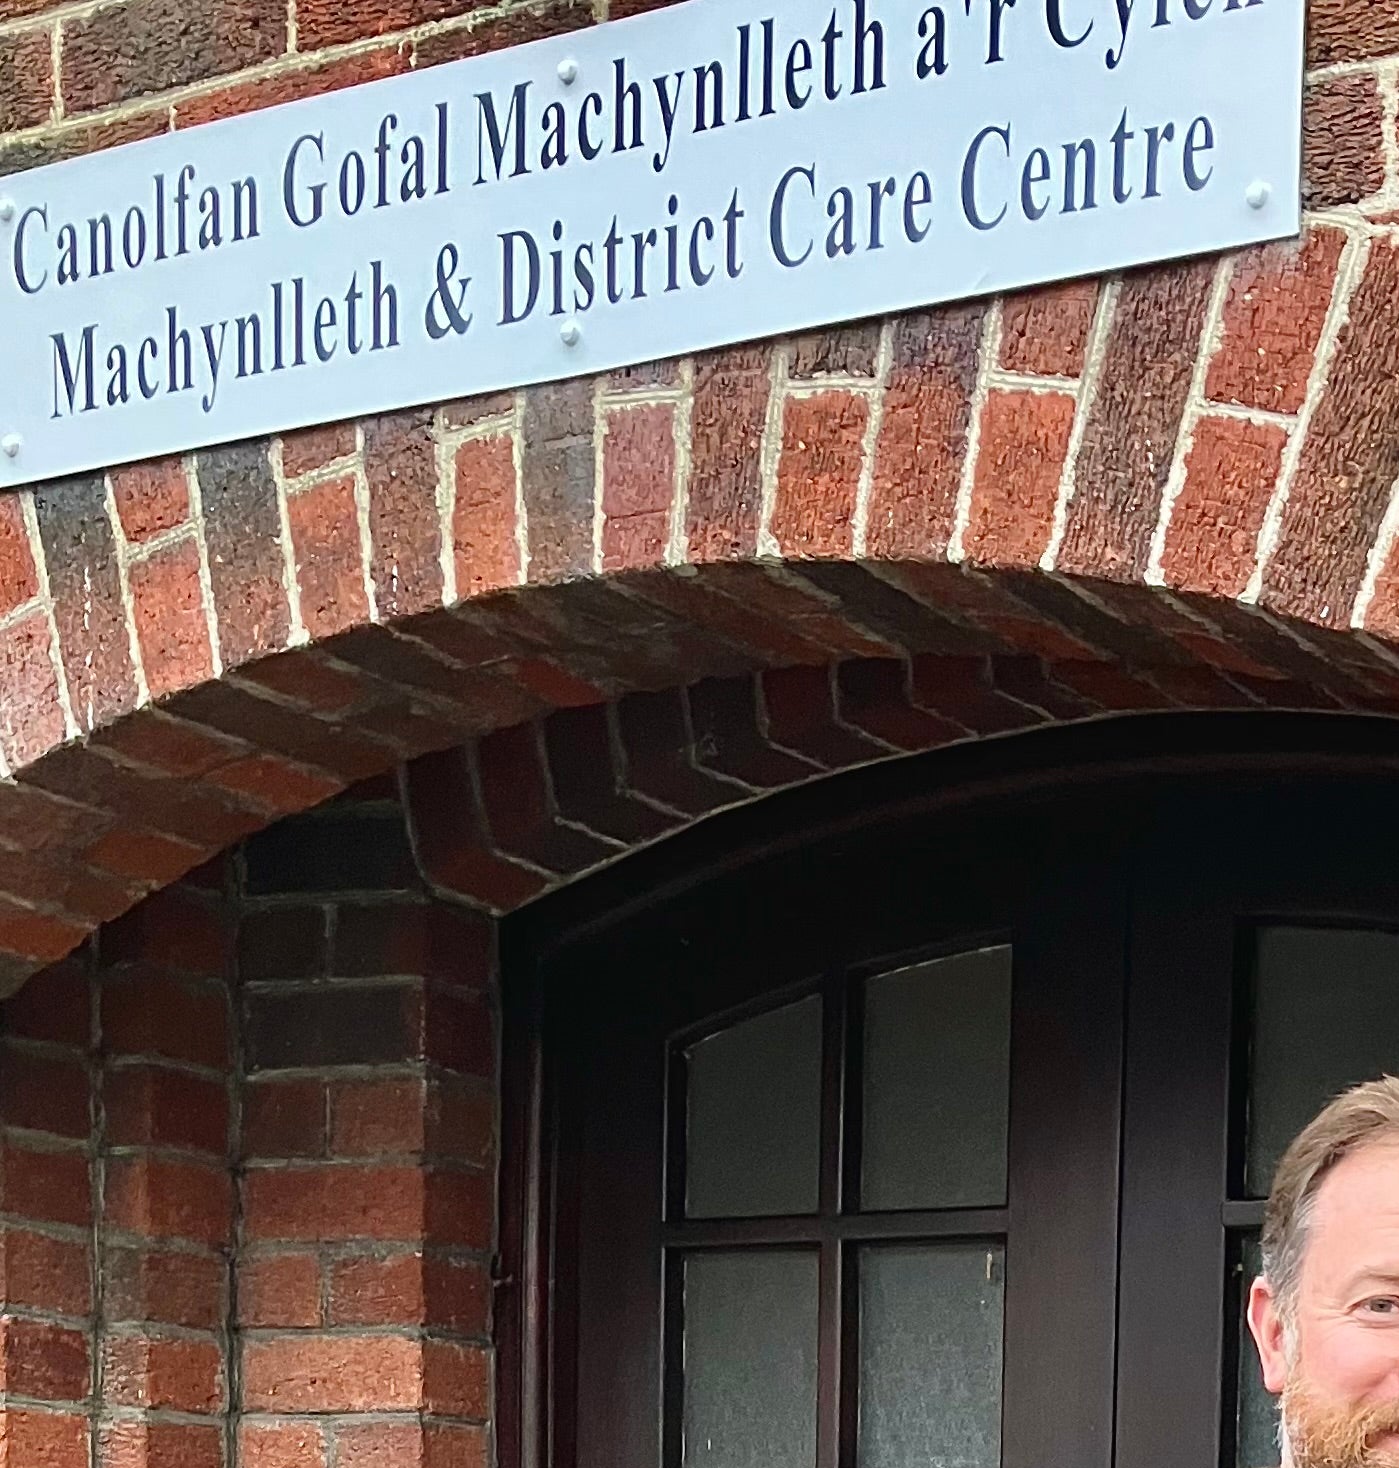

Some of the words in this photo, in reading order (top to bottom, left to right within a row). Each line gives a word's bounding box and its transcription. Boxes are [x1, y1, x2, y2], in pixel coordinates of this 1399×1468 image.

[14, 165, 259, 293] Canolfan
[284, 102, 450, 228] Gofal
[473, 0, 887, 186] Machynlleth
[50, 261, 400, 413] Machynlleth
[425, 244, 473, 339] &
[497, 187, 745, 325] District
[769, 163, 932, 268] Care
[961, 107, 1214, 230] Centre
